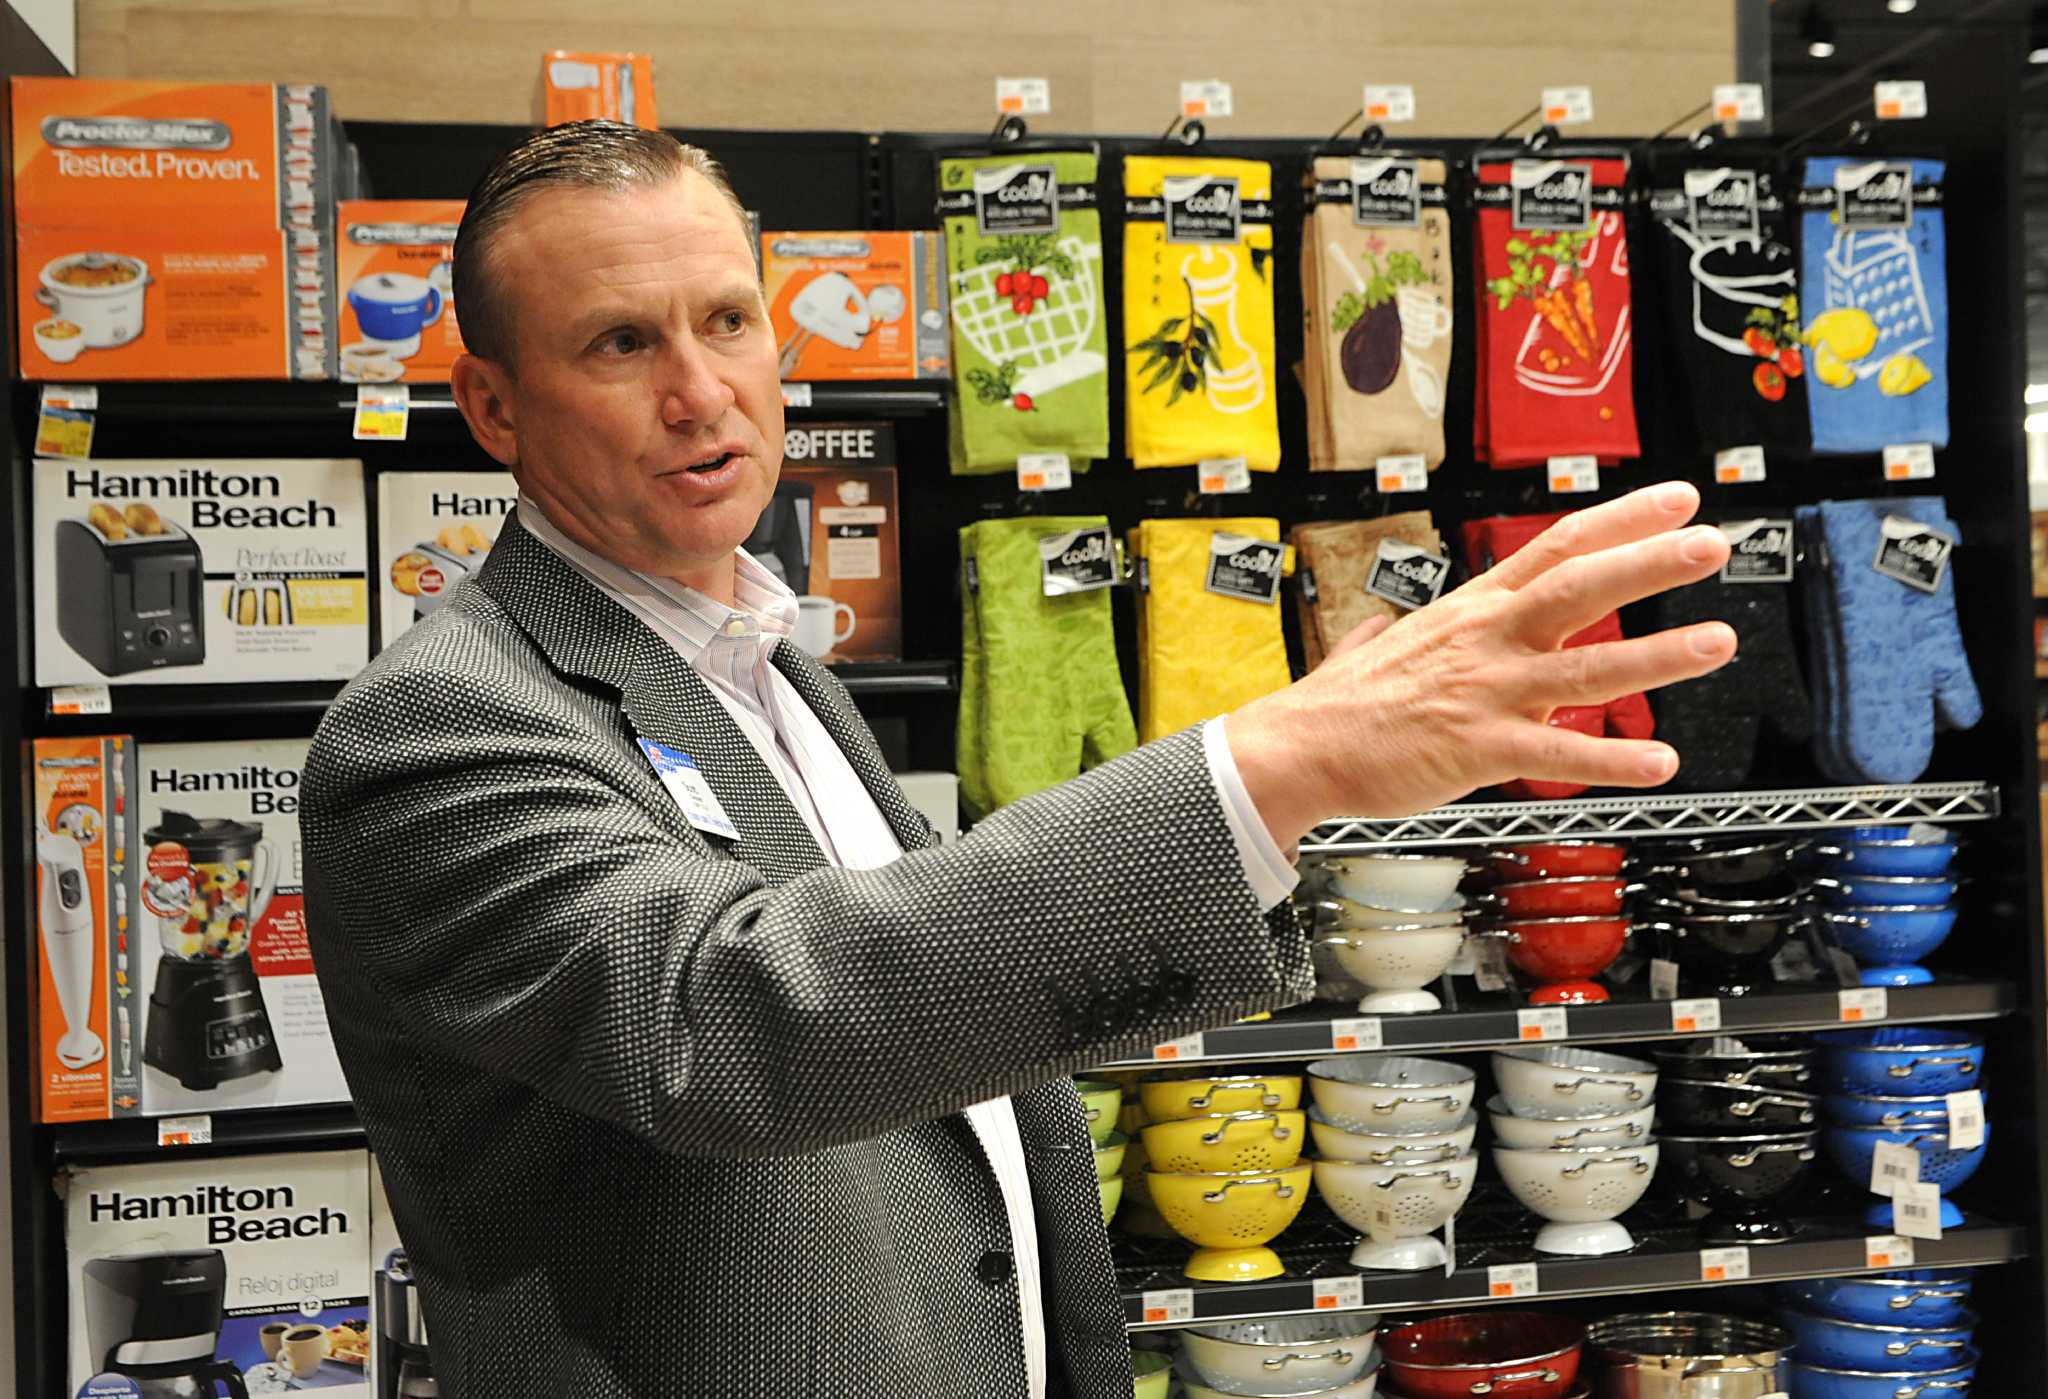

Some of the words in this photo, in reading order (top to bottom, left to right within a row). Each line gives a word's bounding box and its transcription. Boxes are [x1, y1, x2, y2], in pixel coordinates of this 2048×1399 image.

[55, 120, 149, 141] Proctor
[151, 123, 215, 143] Silex
[51, 149, 153, 178] Tested.
[156, 152, 260, 180] Proven.
[784, 429, 875, 459] OFFEE
[66, 469, 280, 498] Hamilton
[191, 500, 337, 528] Beach
[151, 766, 299, 793] Hamilto
[90, 1186, 293, 1222] Hamilton
[208, 1207, 347, 1244] Beach
[239, 1276, 283, 1296] Reloj
[287, 1268, 339, 1294] digital
